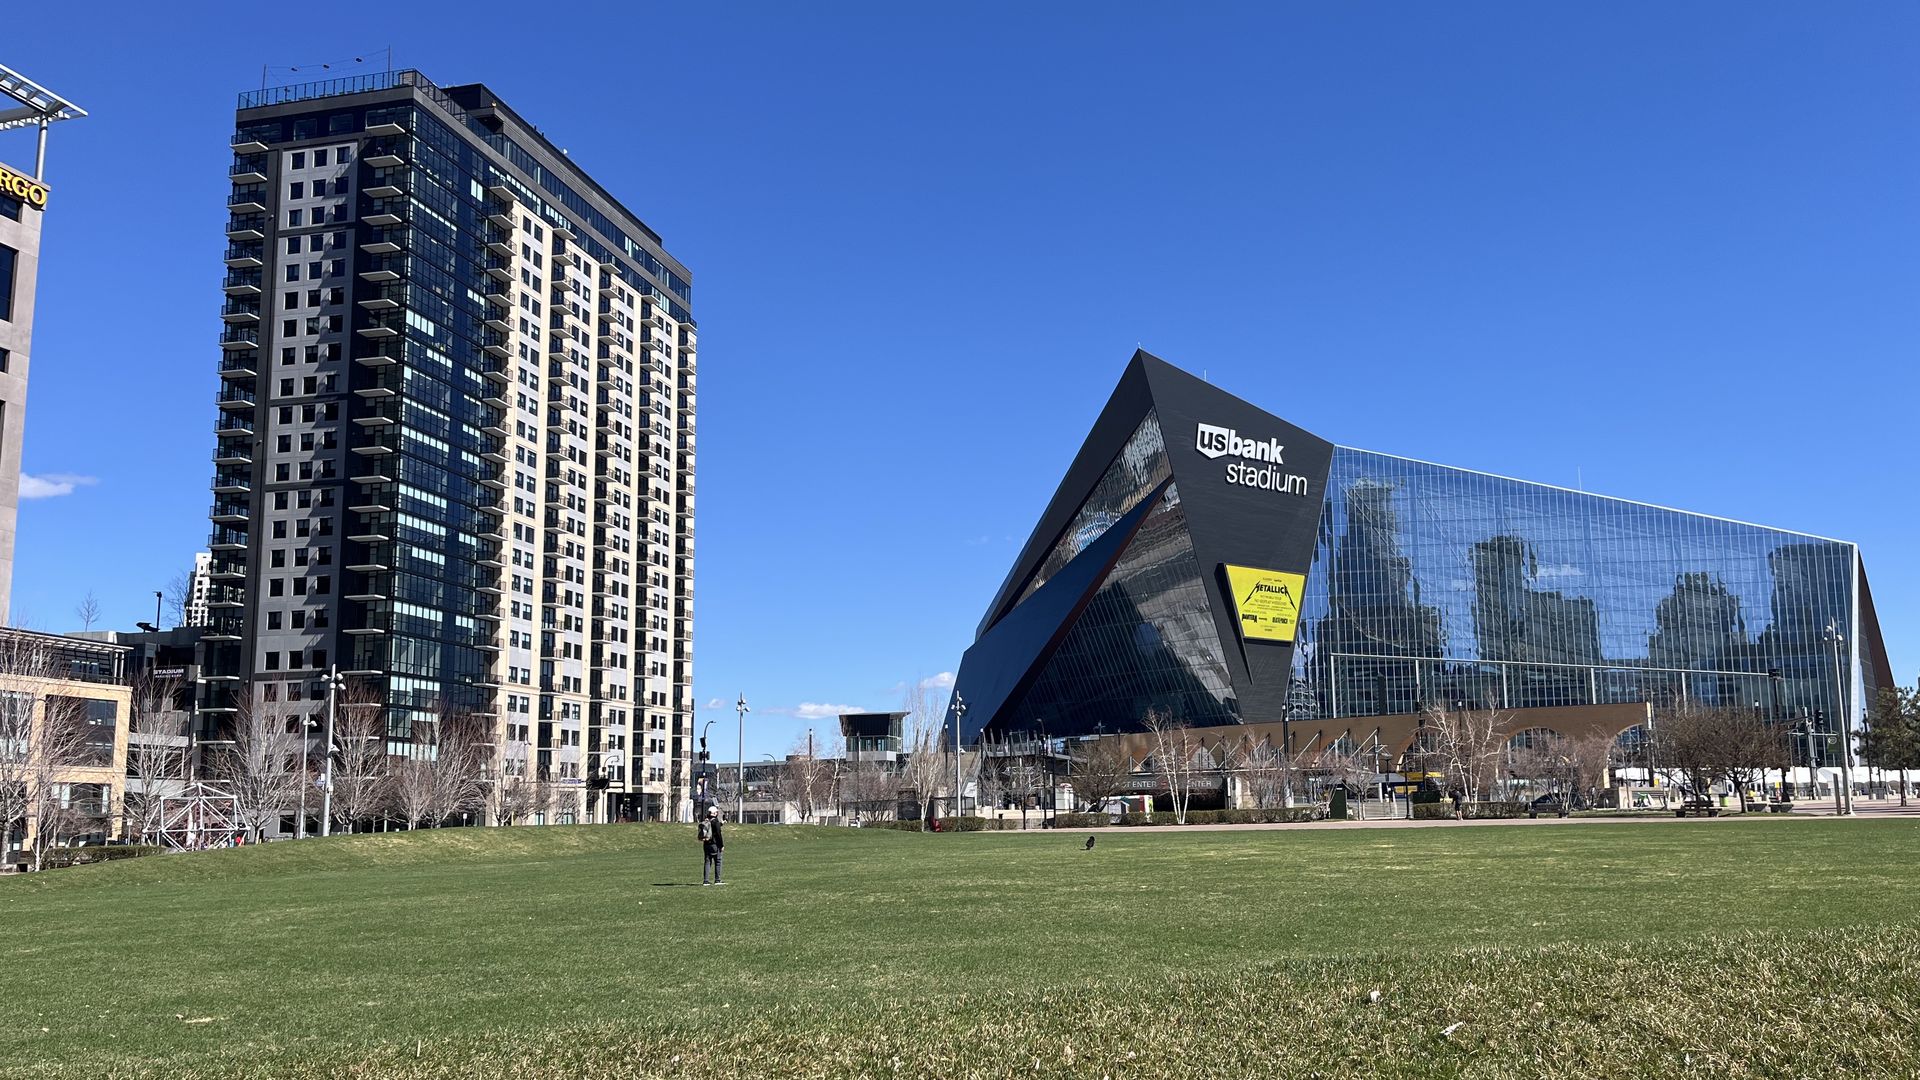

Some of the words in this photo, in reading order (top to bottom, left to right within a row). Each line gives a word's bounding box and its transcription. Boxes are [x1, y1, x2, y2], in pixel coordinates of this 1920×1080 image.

[0, 168, 48, 205] RGO
[1226, 461, 1308, 496] stadium
[1132, 780, 1158, 788] ENTER
